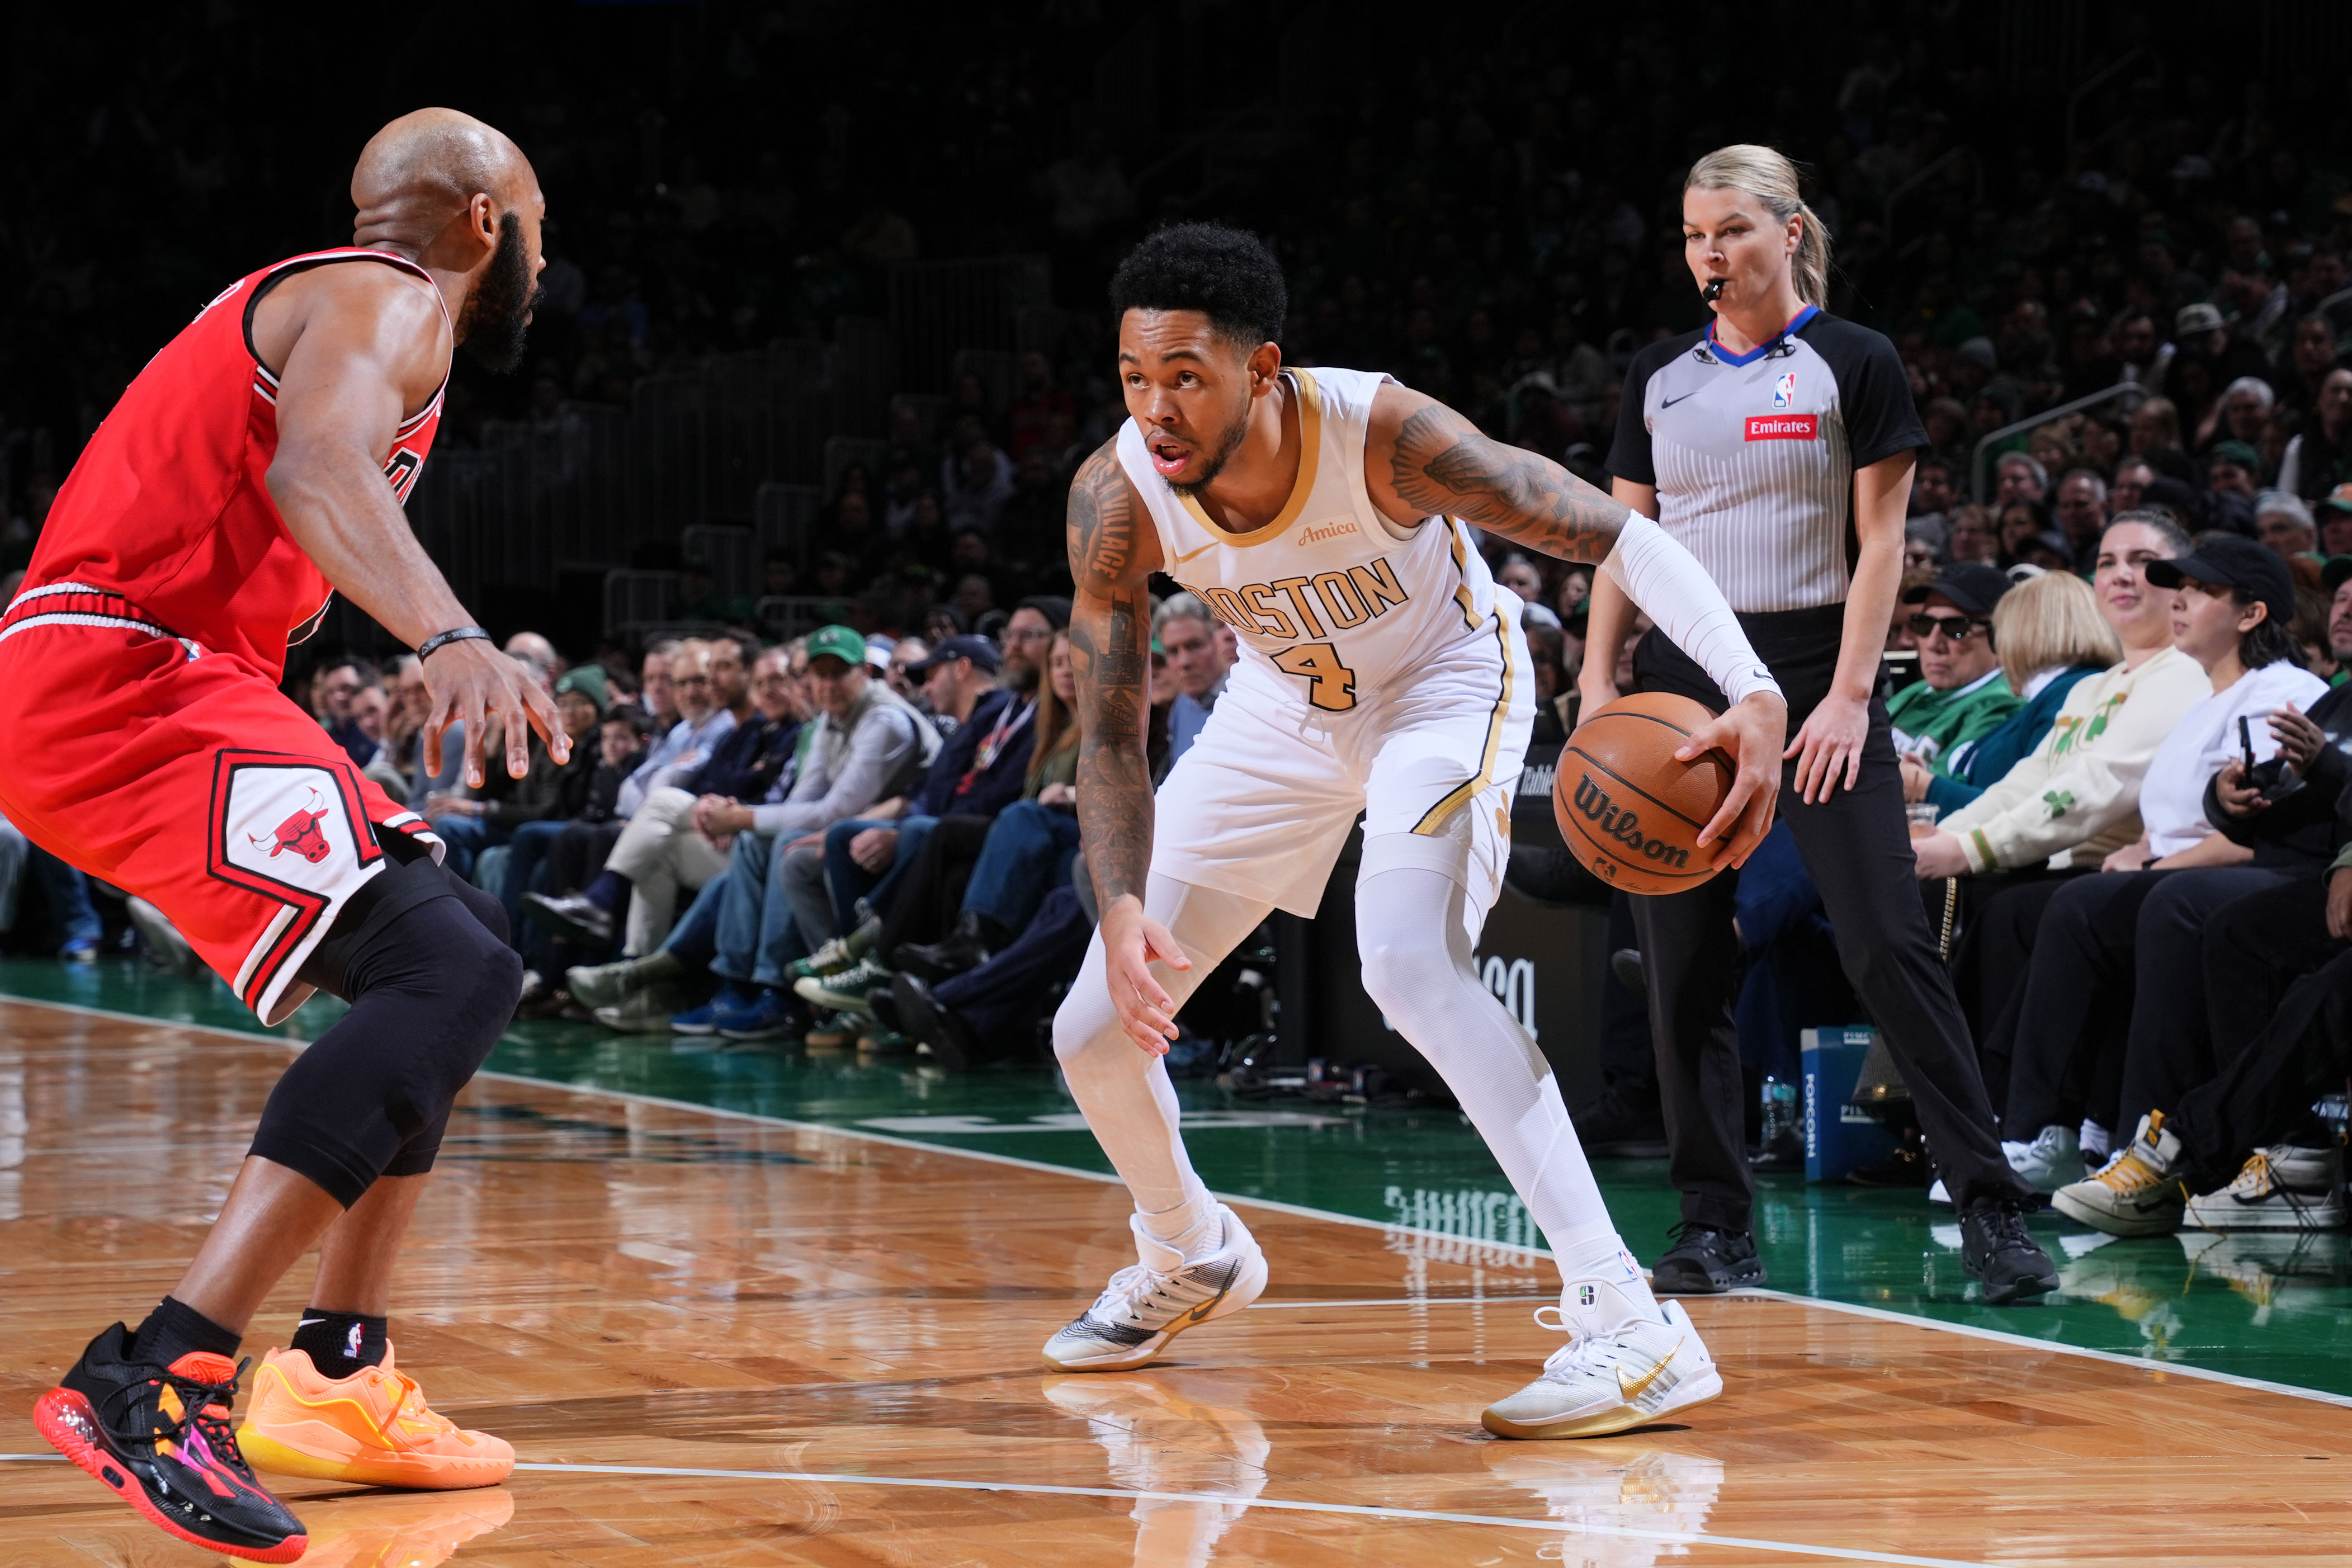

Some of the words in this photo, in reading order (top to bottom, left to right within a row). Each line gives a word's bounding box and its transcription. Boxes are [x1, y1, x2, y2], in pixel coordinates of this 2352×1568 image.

[1751, 420, 1811, 435] Emirates
[1298, 519, 1358, 547] Amica
[1177, 558, 1409, 639] BOSTON
[1269, 643, 1357, 711] 4
[1574, 772, 1690, 868] Wilson
[1805, 1073, 1816, 1159] POPCORN
